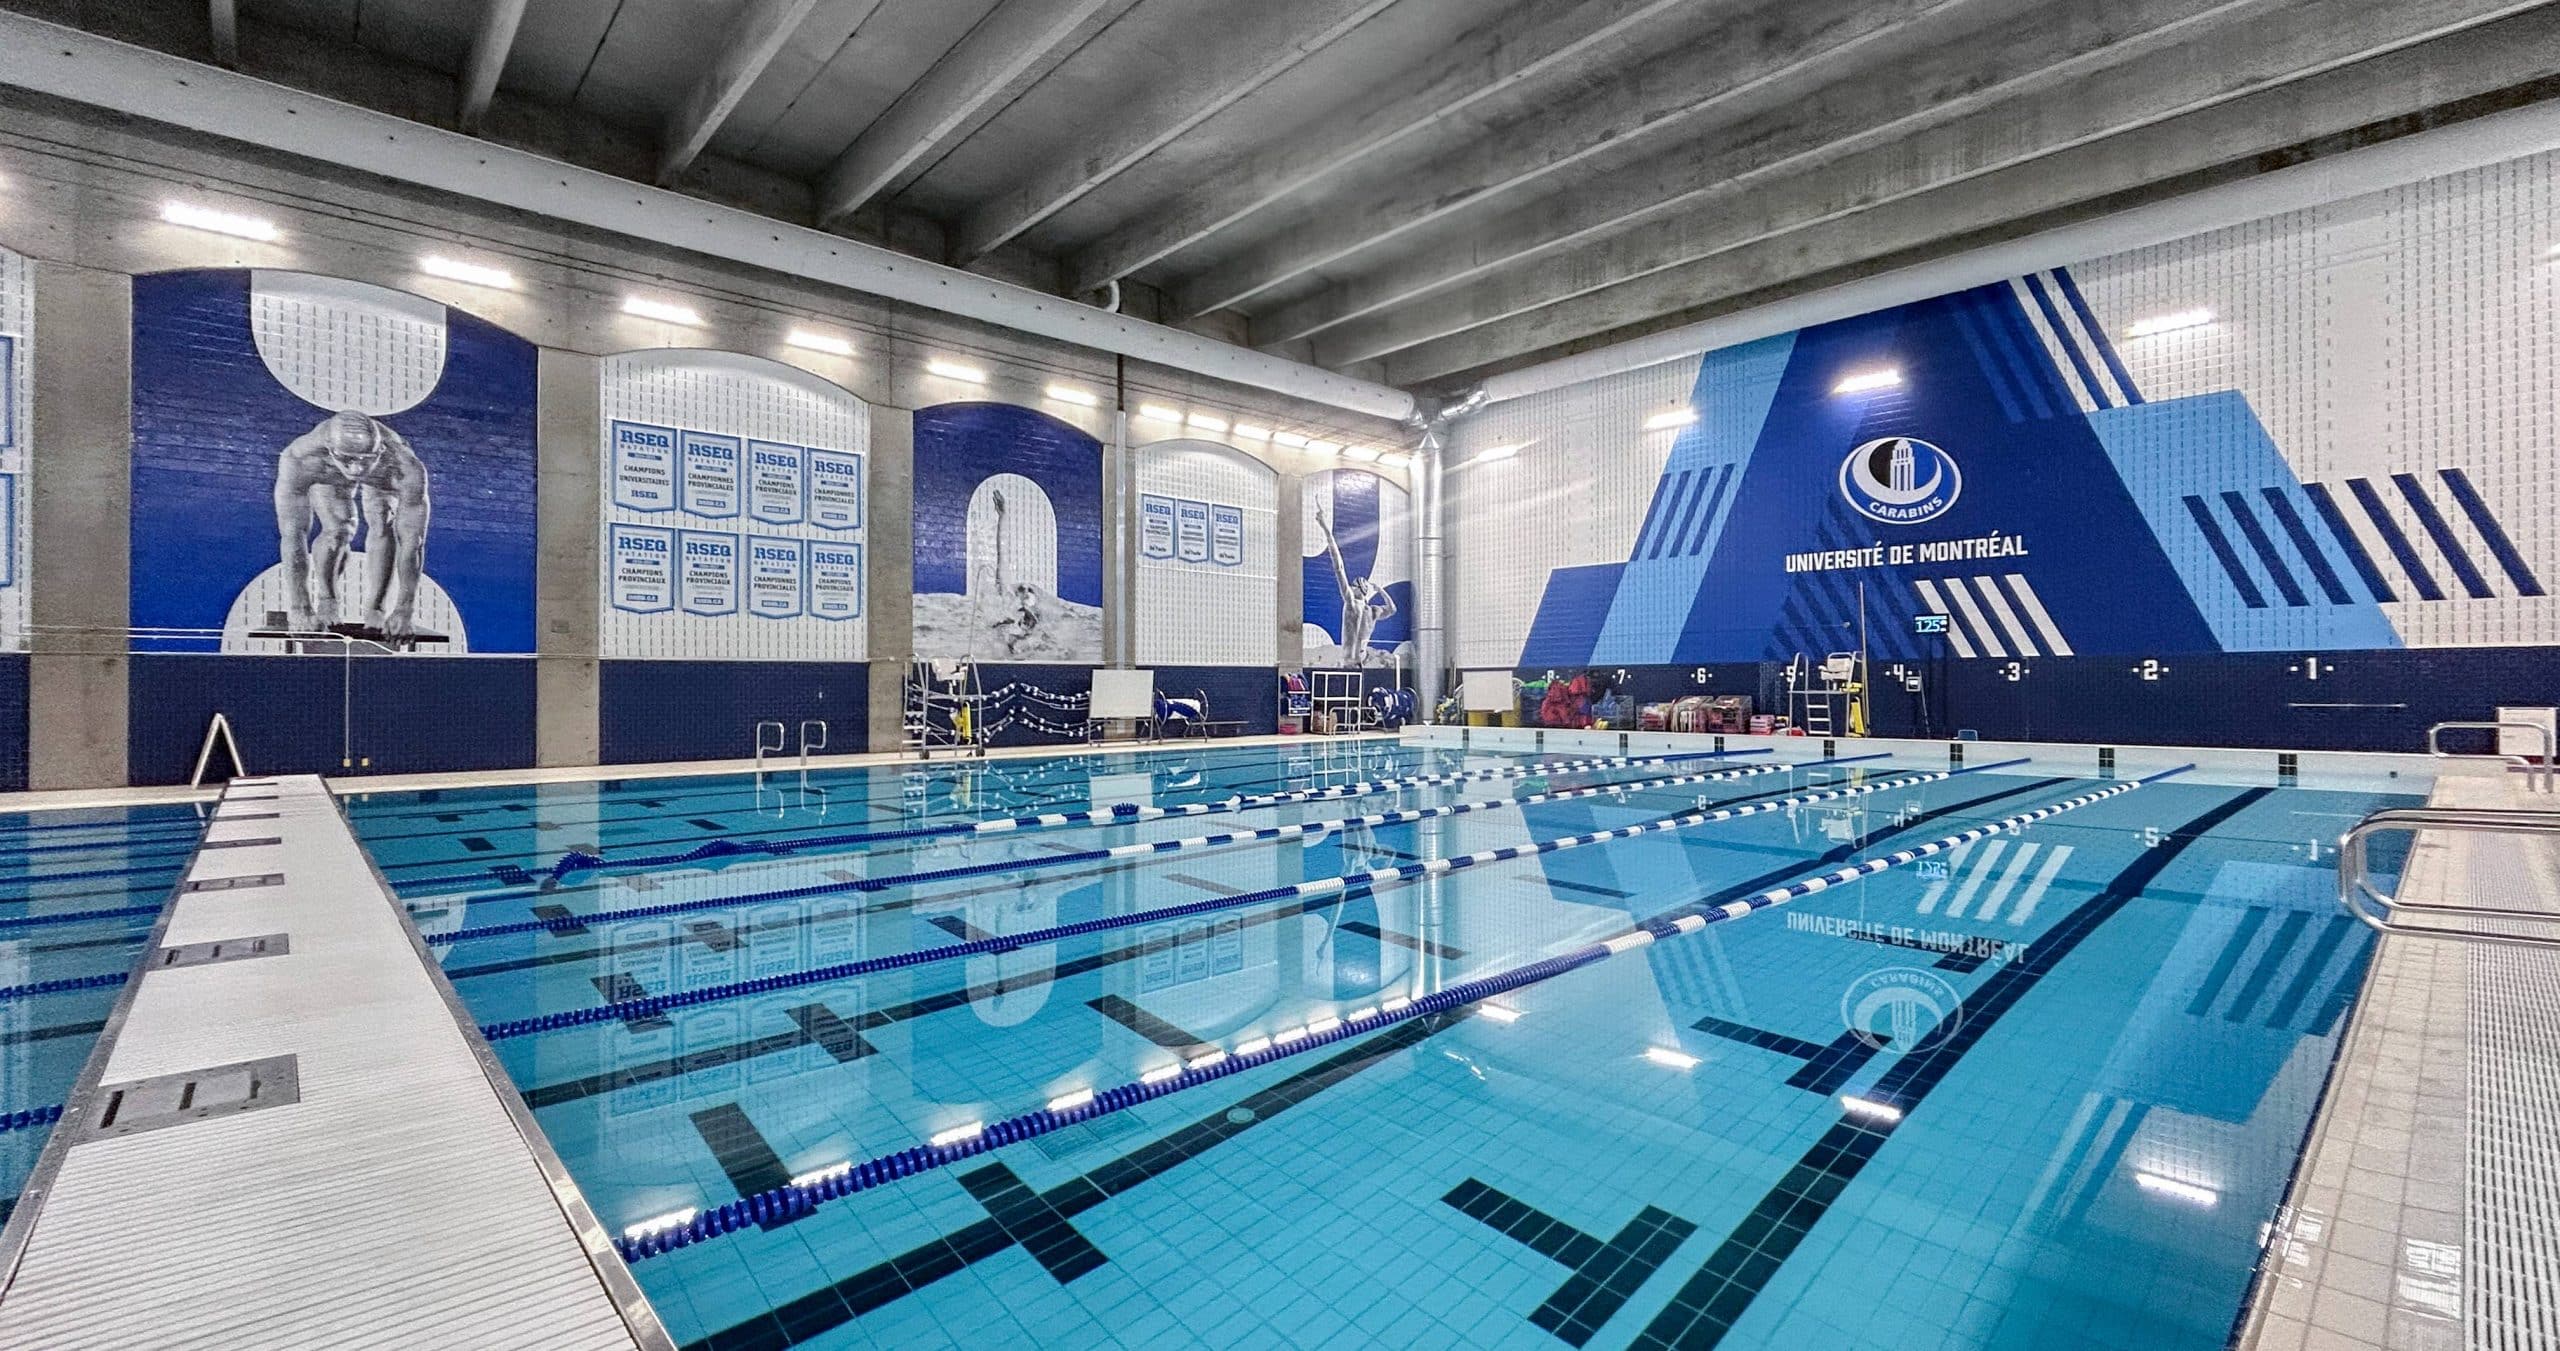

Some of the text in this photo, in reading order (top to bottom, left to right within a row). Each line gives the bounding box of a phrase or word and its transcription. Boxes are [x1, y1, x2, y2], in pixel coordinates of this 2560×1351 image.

[621, 429, 669, 447] RSEQ
[688, 443, 733, 460] RSEQ
[755, 452, 797, 468] RSEQ
[815, 460, 854, 475] RSEQ
[624, 465, 665, 475] CHAMPIONS
[688, 473, 734, 483] CHAMPIONNES
[688, 480, 734, 491] PROVINCIALES
[759, 479, 794, 489] CHAMPIONS
[631, 490, 658, 499] RSEQ
[1145, 503, 1171, 515] RSEQ
[1181, 508, 1205, 520] RSEQ
[1869, 496, 1943, 518] CARABINS
[1215, 513, 1239, 524] RSEQ
[618, 537, 668, 552] RSEQ
[686, 542, 732, 557] RSEQ
[1785, 530, 2029, 573] UNIVERSITÉ DE MONTRÉAL
[754, 547, 797, 561] RSEQ
[815, 552, 854, 565] RSEQ
[622, 567, 663, 576] CHAMPIONS
[689, 570, 728, 579] CHAMPIONS
[618, 575, 666, 584] PROVINCIAUX
[686, 577, 730, 585] PROVINCIAUX
[1696, 667, 1707, 684] 6
[1786, 665, 1796, 683] 5
[1893, 664, 1904, 682] 4
[2007, 661, 2021, 682] 3
[2143, 659, 2159, 681] 2
[2305, 657, 2318, 680] 1
[1617, 669, 1626, 685] 7
